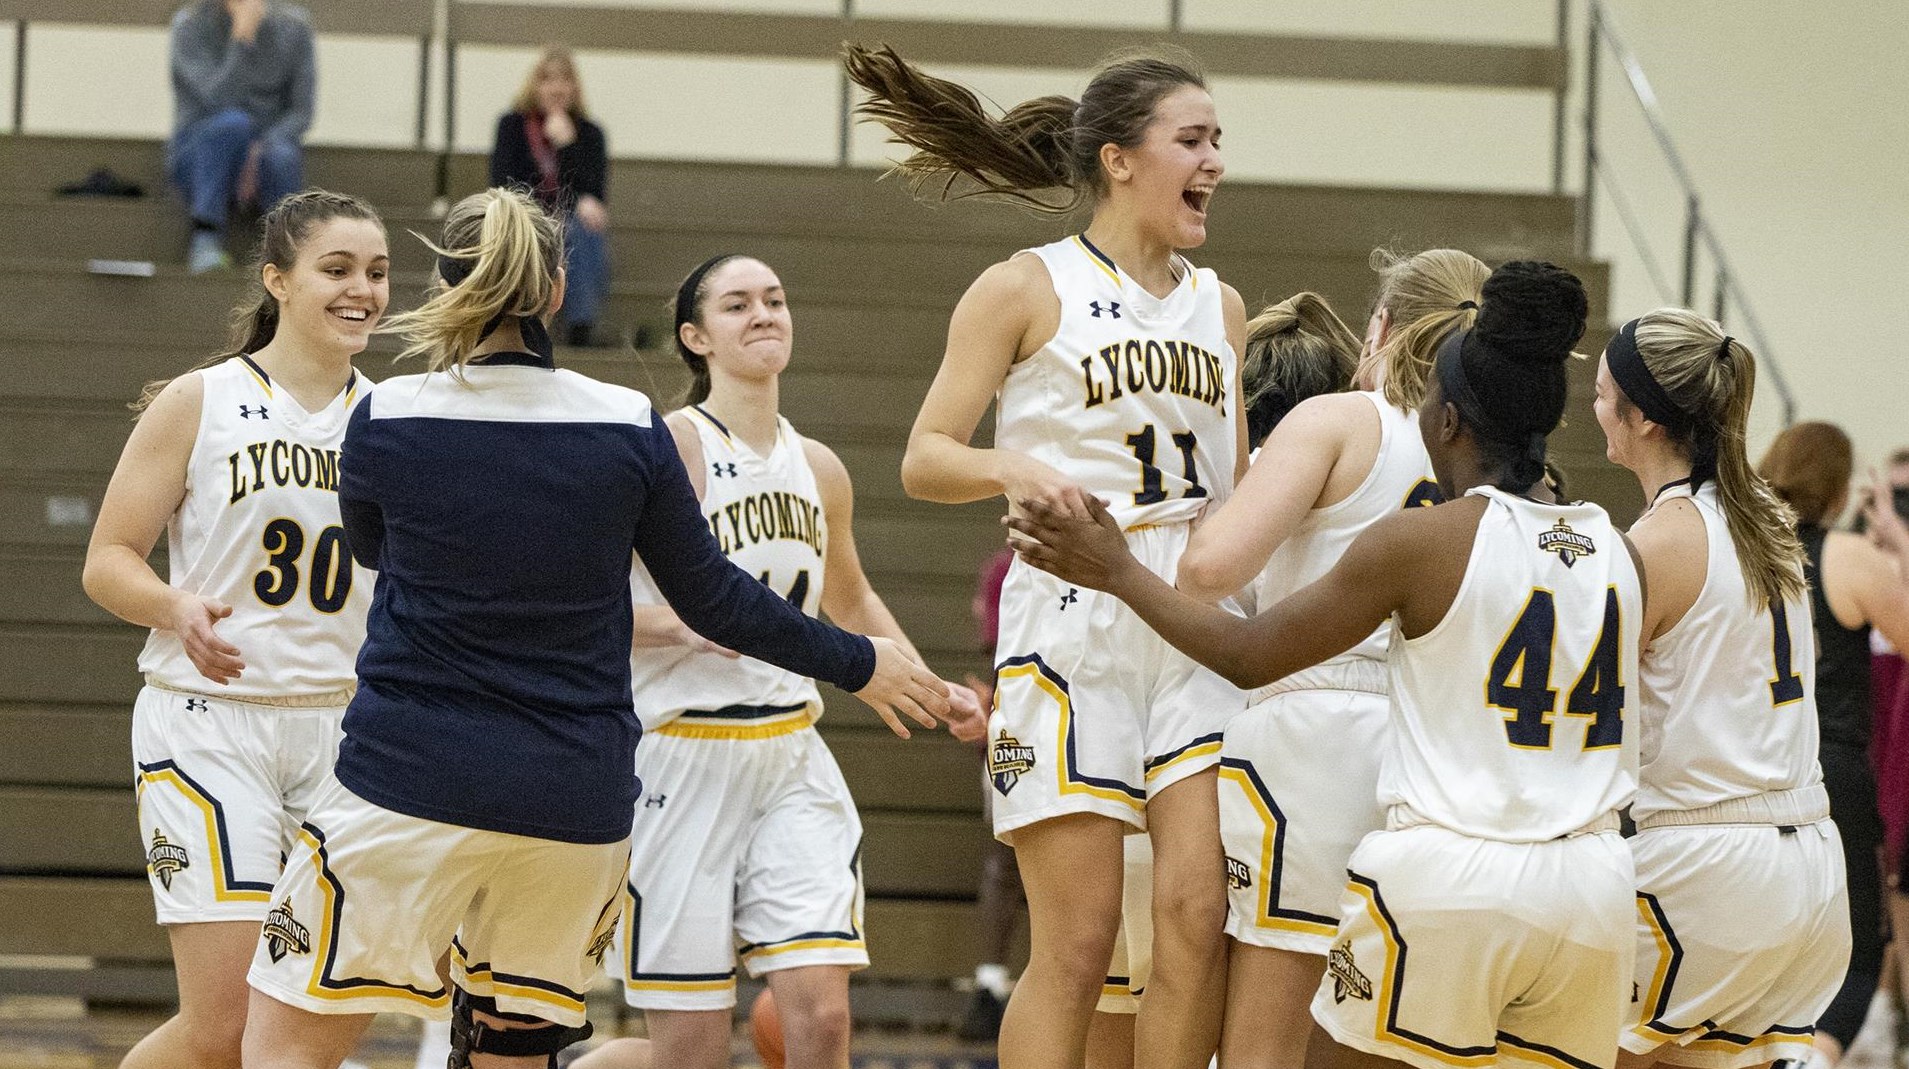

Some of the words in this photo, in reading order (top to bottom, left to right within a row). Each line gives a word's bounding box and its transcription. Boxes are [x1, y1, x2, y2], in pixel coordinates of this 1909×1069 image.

[228, 438, 343, 506] LYCOM
[1125, 422, 1208, 506] 11
[253, 515, 353, 615] 30
[1540, 531, 1593, 550] LYCOMING
[1484, 583, 1625, 753] 44
[994, 747, 1034, 763] OMING
